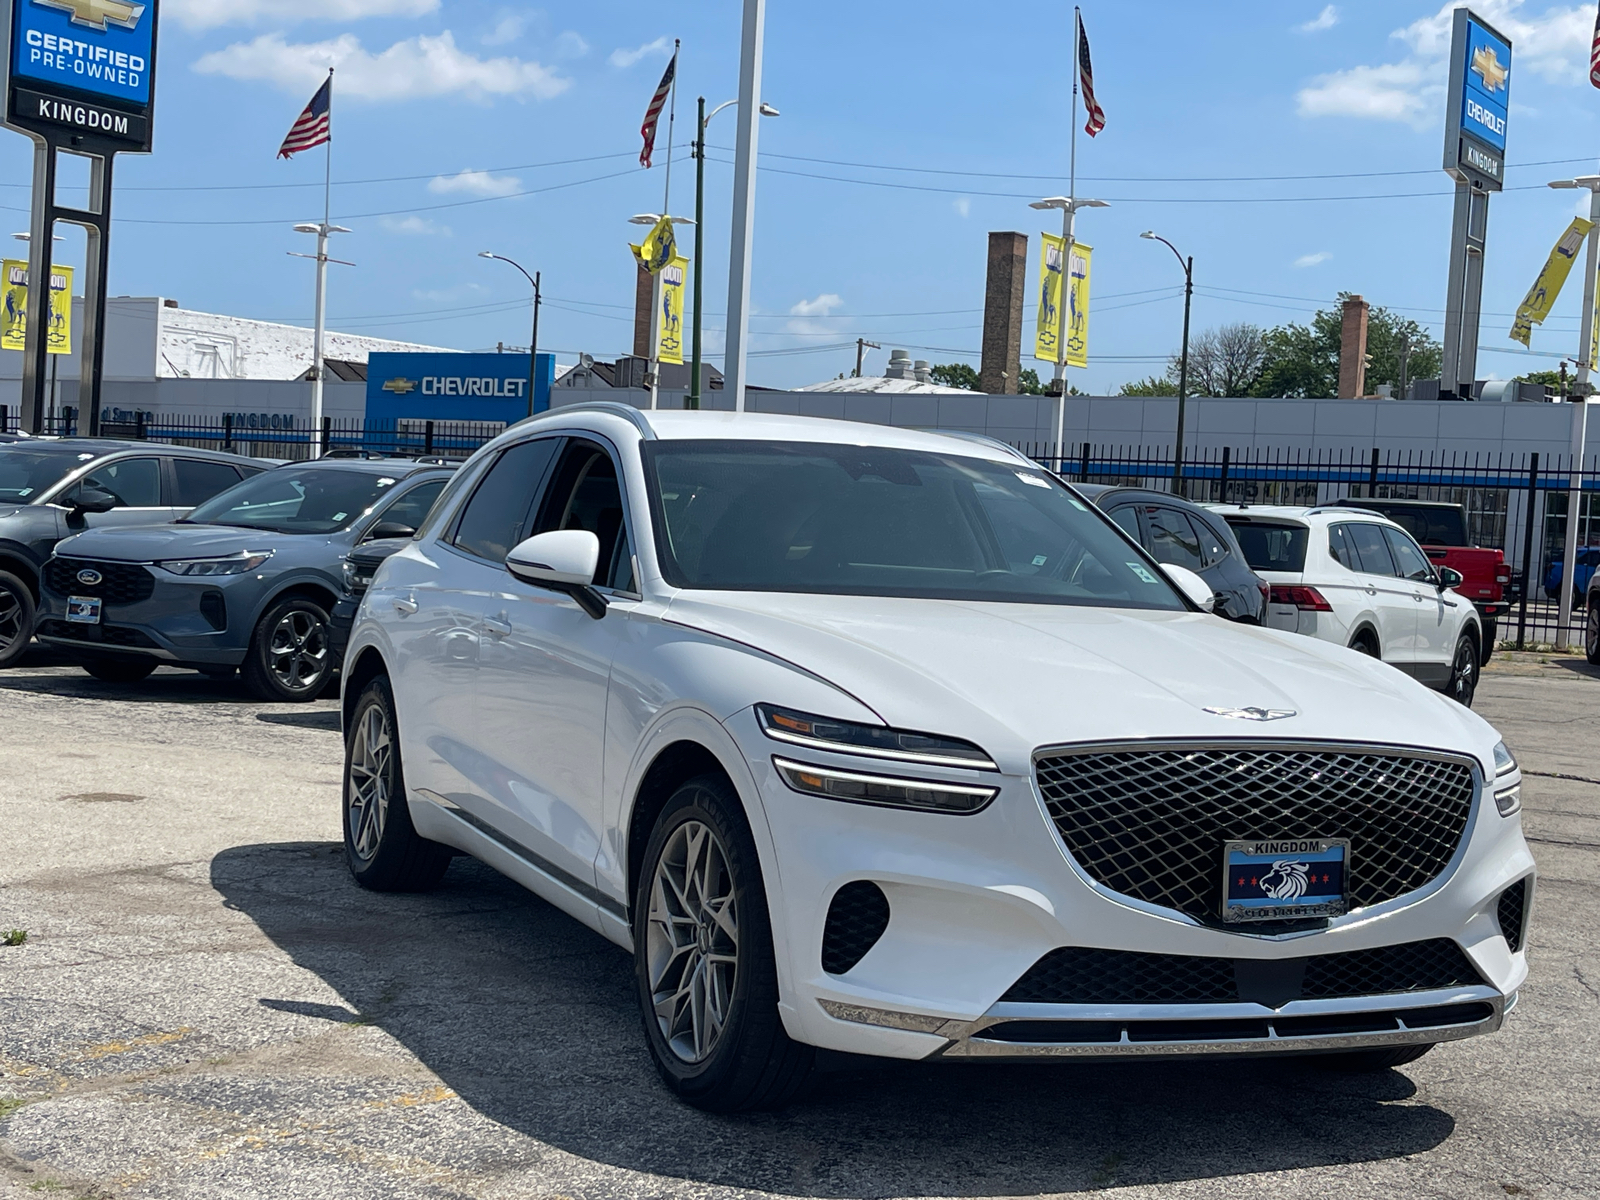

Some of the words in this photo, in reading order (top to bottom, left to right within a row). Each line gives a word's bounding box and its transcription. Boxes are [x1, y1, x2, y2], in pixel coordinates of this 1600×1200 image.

[26, 29, 145, 72] CERTIFIED
[30, 48, 139, 88] PRE-OWNED
[39, 98, 128, 134] KINGDOM
[1467, 98, 1505, 136] CHEVROLET
[1467, 146, 1498, 176] KINGDOM
[51, 274, 67, 289] om
[421, 376, 528, 397] CHEVROLET
[112, 407, 153, 421] Servce
[1255, 840, 1320, 854] KINGDOM
